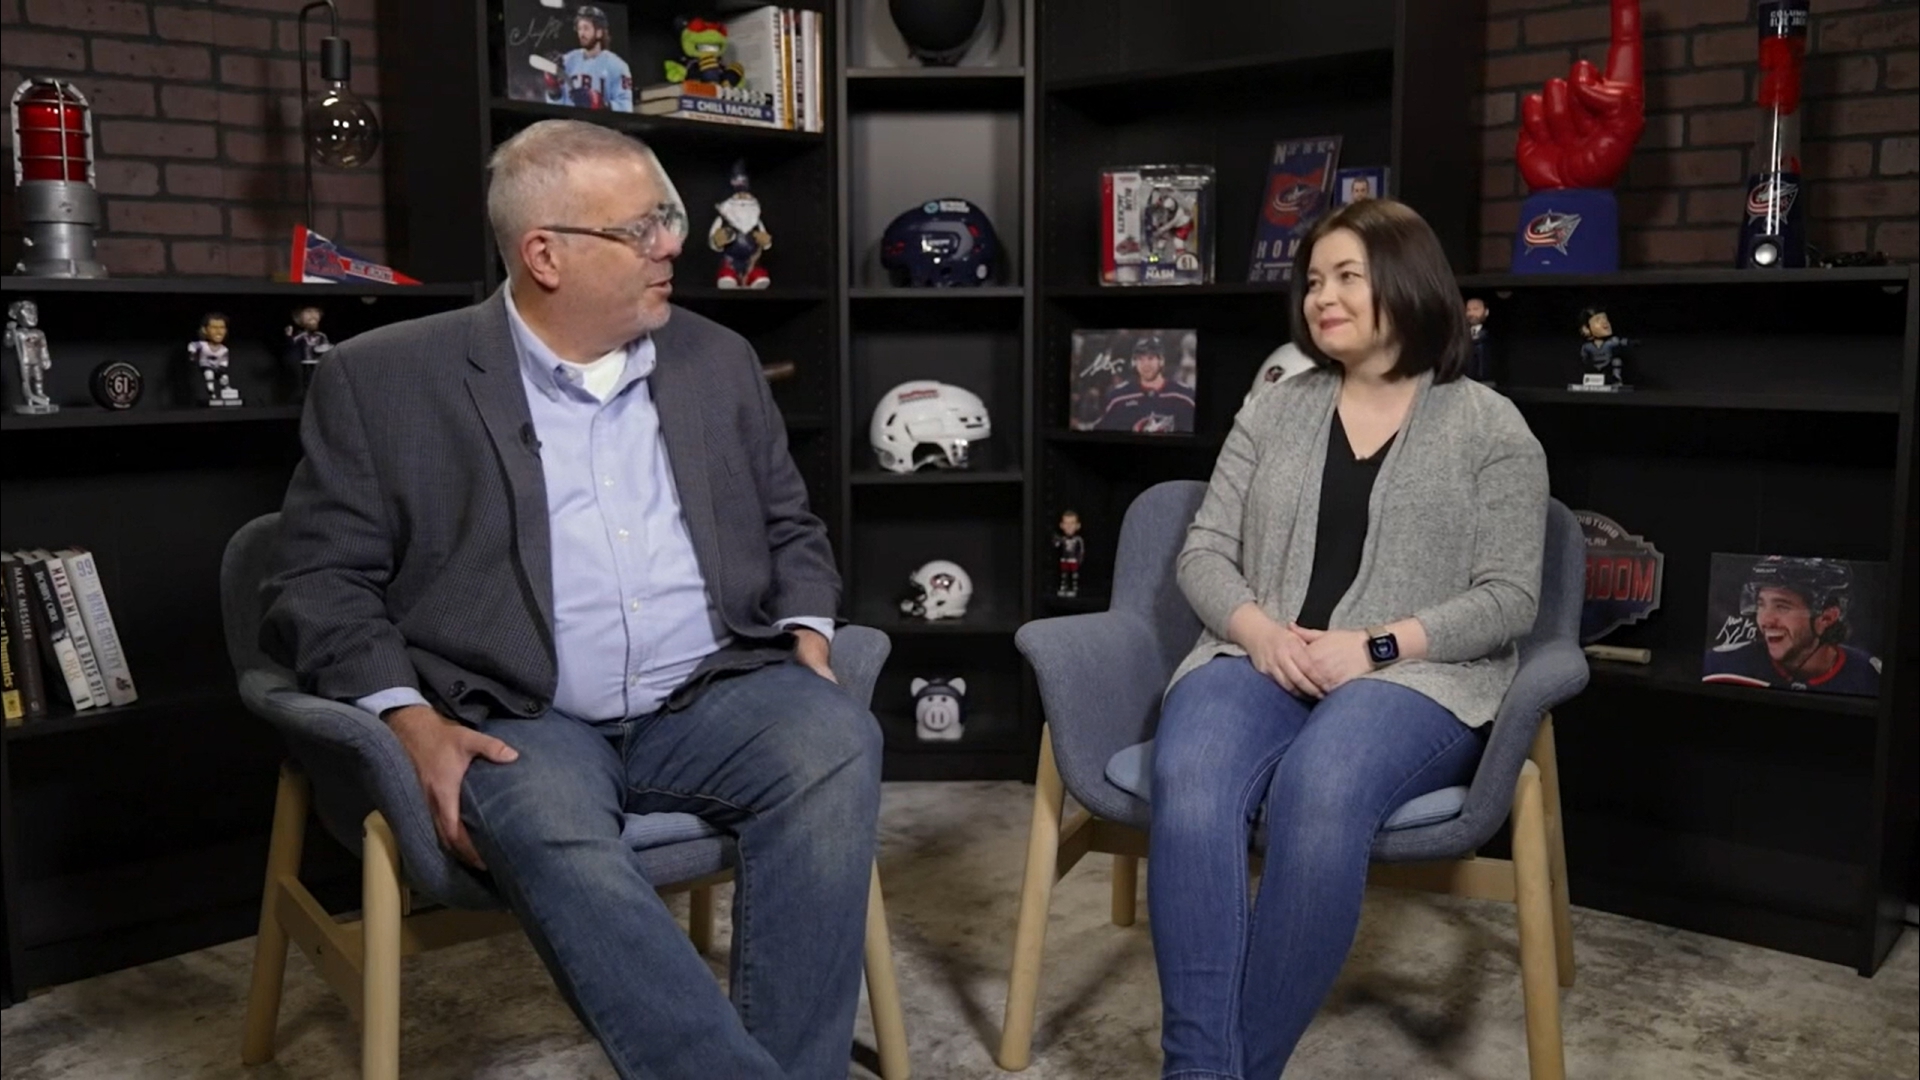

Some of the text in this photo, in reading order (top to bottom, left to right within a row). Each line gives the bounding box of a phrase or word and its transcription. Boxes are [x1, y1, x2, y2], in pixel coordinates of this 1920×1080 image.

[696, 100, 724, 114] CHILL
[726, 103, 763, 119] FACTOR
[1256, 238, 1302, 260] HOM
[114, 376, 129, 394] 61
[13, 566, 26, 596] MARK
[76, 558, 94, 577] 99
[51, 567, 78, 619] MAX DOMI
[18, 598, 33, 641] MESSIER
[86, 593, 110, 625] WAYNE
[98, 624, 123, 671] GRETZKY
[63, 651, 82, 681] ORR
[75, 635, 106, 698] NO DAYS OFF
